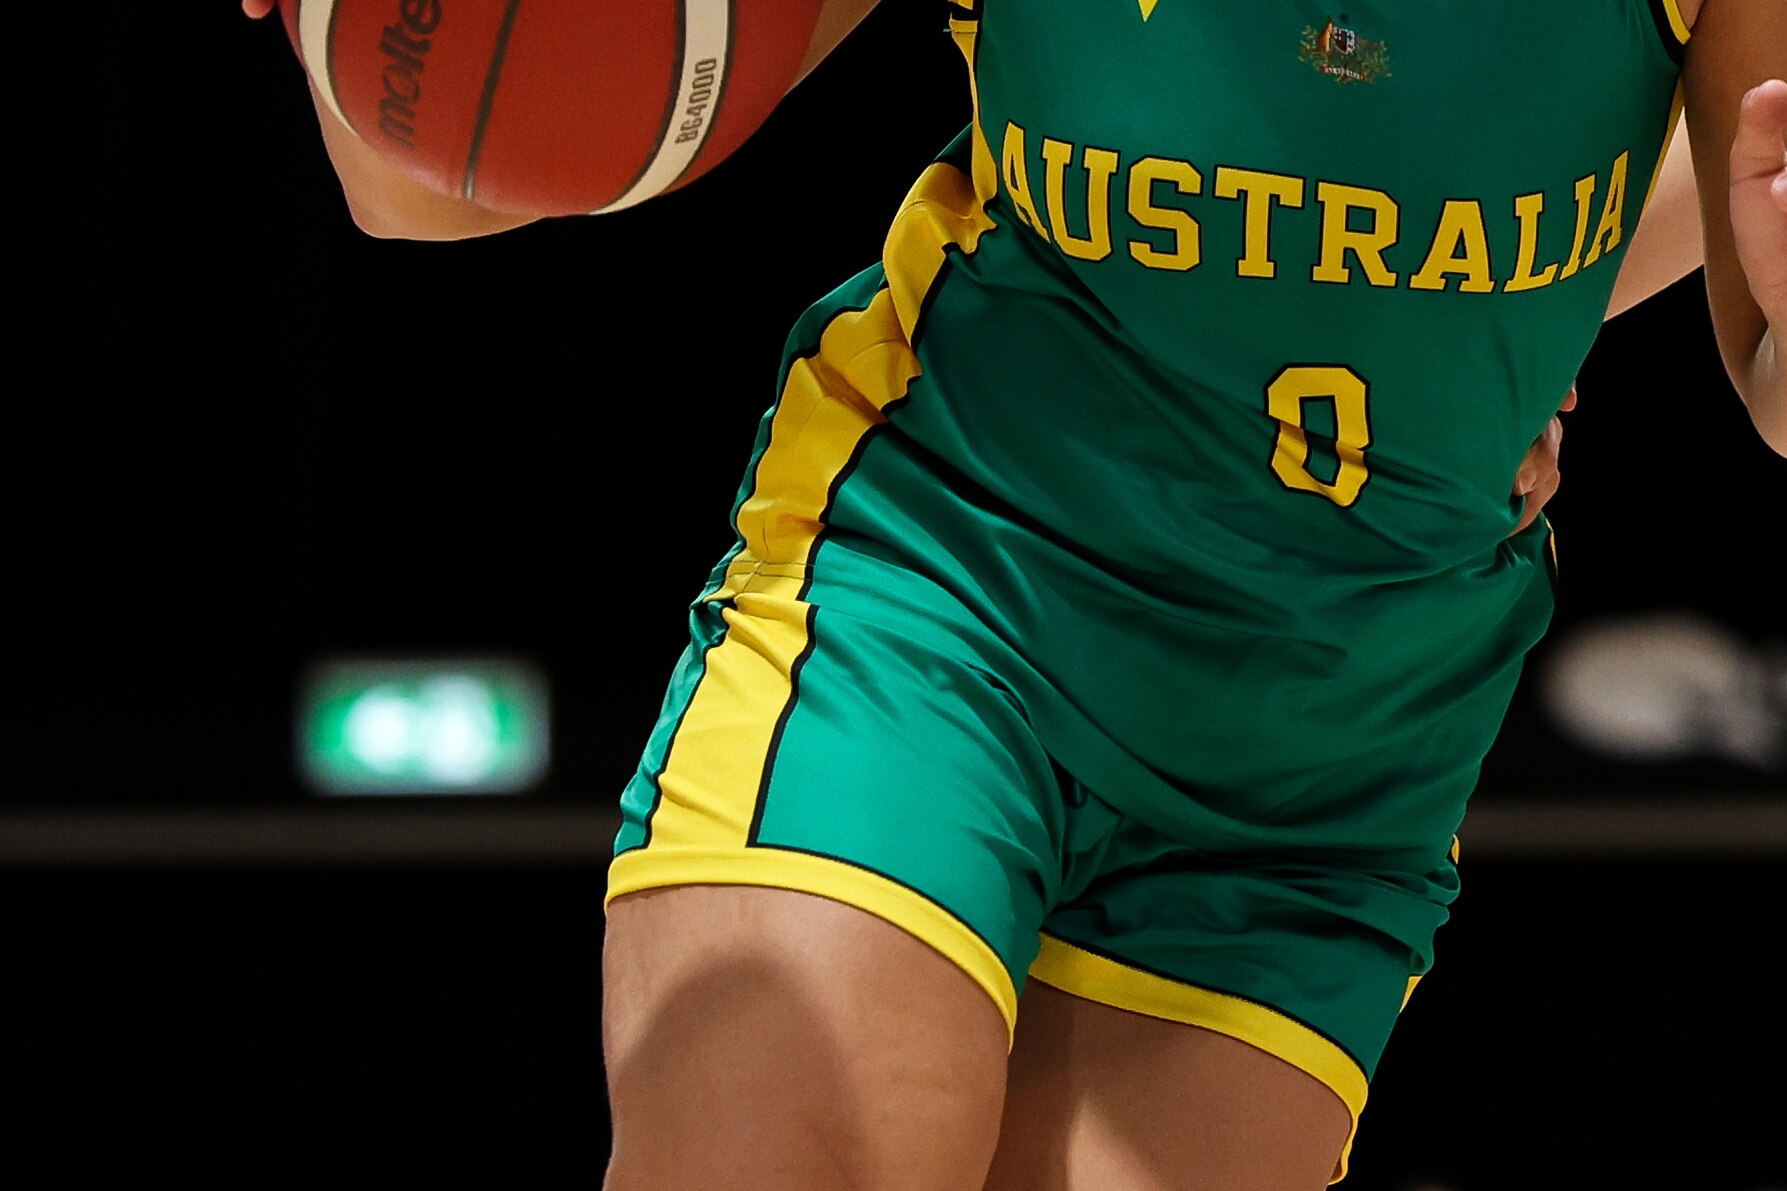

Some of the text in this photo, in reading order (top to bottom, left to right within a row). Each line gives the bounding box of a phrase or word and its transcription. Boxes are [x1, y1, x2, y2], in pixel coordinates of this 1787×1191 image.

[674, 58, 717, 144] BG4000
[1001, 120, 1630, 295] AUSTRALIA
[1263, 362, 1371, 508] 0
